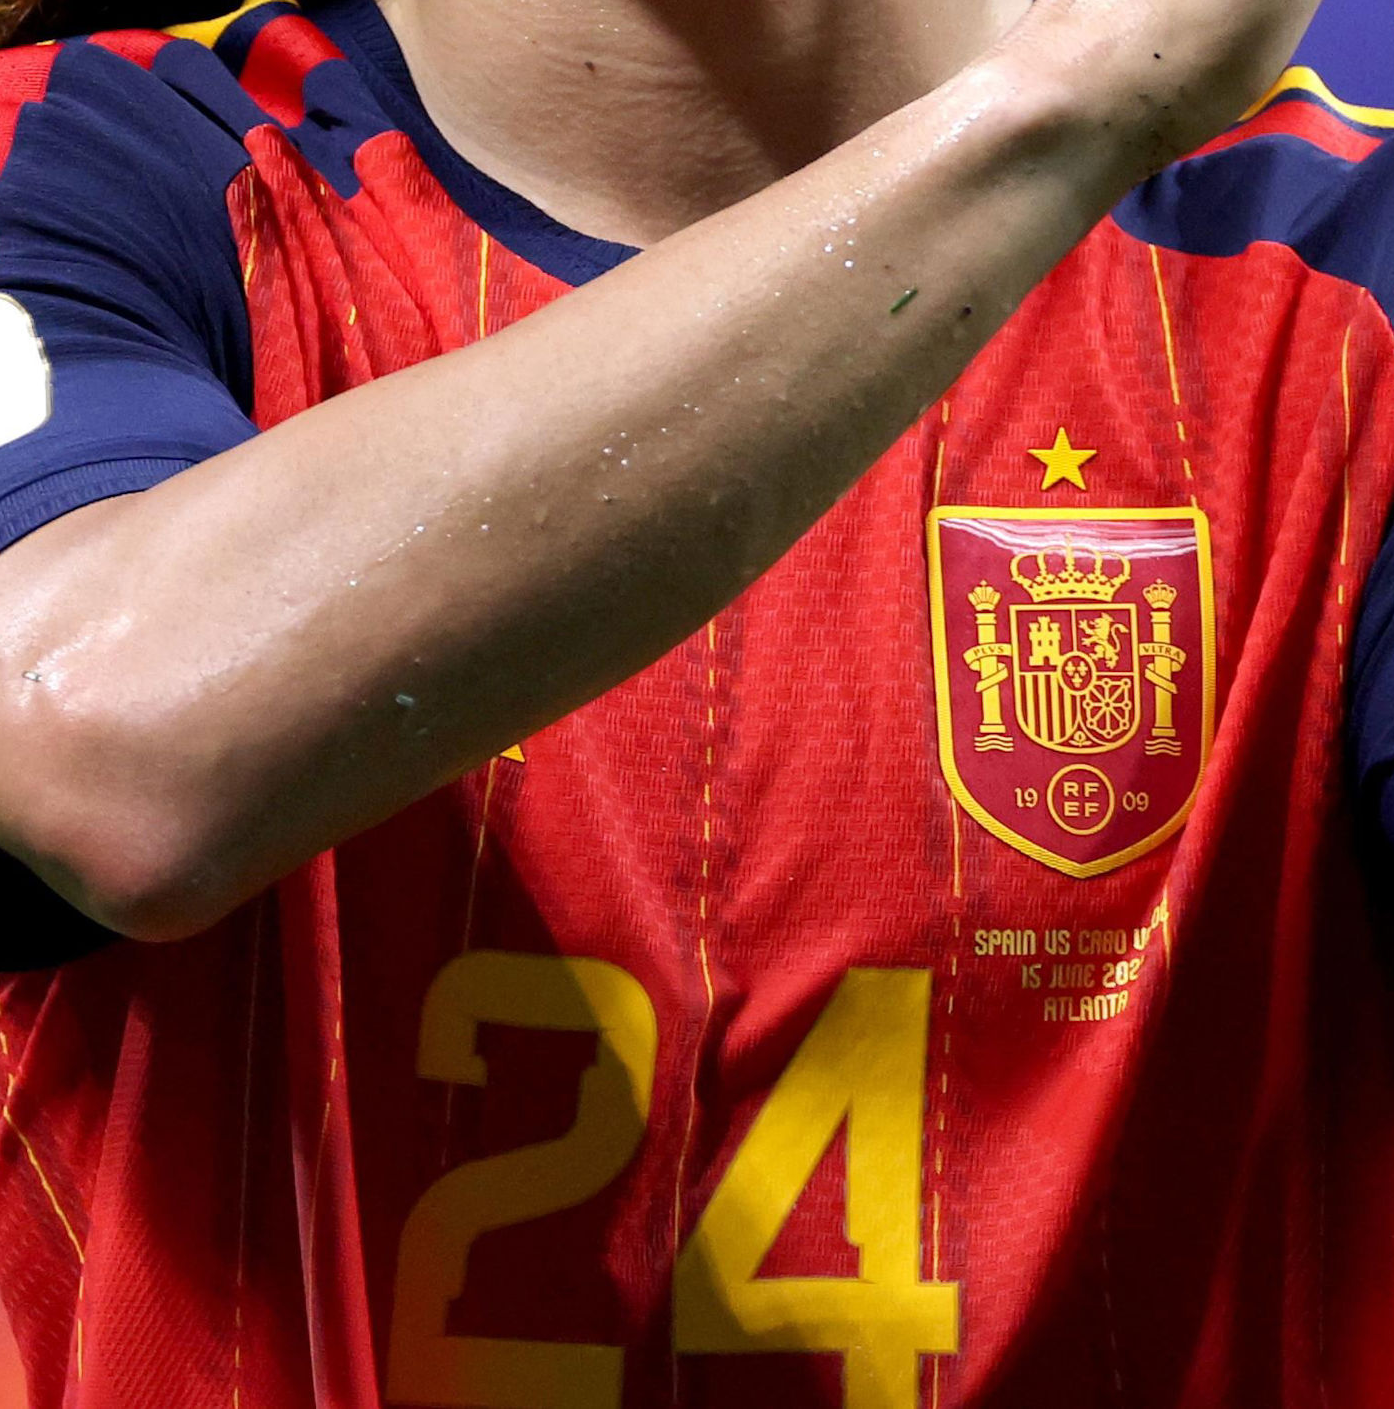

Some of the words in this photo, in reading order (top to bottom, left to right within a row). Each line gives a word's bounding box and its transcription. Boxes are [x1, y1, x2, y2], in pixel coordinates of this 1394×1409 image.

[1014, 787, 1038, 808] 19
[1122, 791, 1149, 812] 09
[974, 929, 1036, 956] SPAIN
[1078, 929, 1127, 955] CABO
[1021, 963, 1042, 989] 15
[1048, 963, 1095, 989] JUNE
[1102, 955, 1145, 988] 202
[1044, 990, 1129, 1022] ATLANTA
[387, 948, 959, 1409] 24
